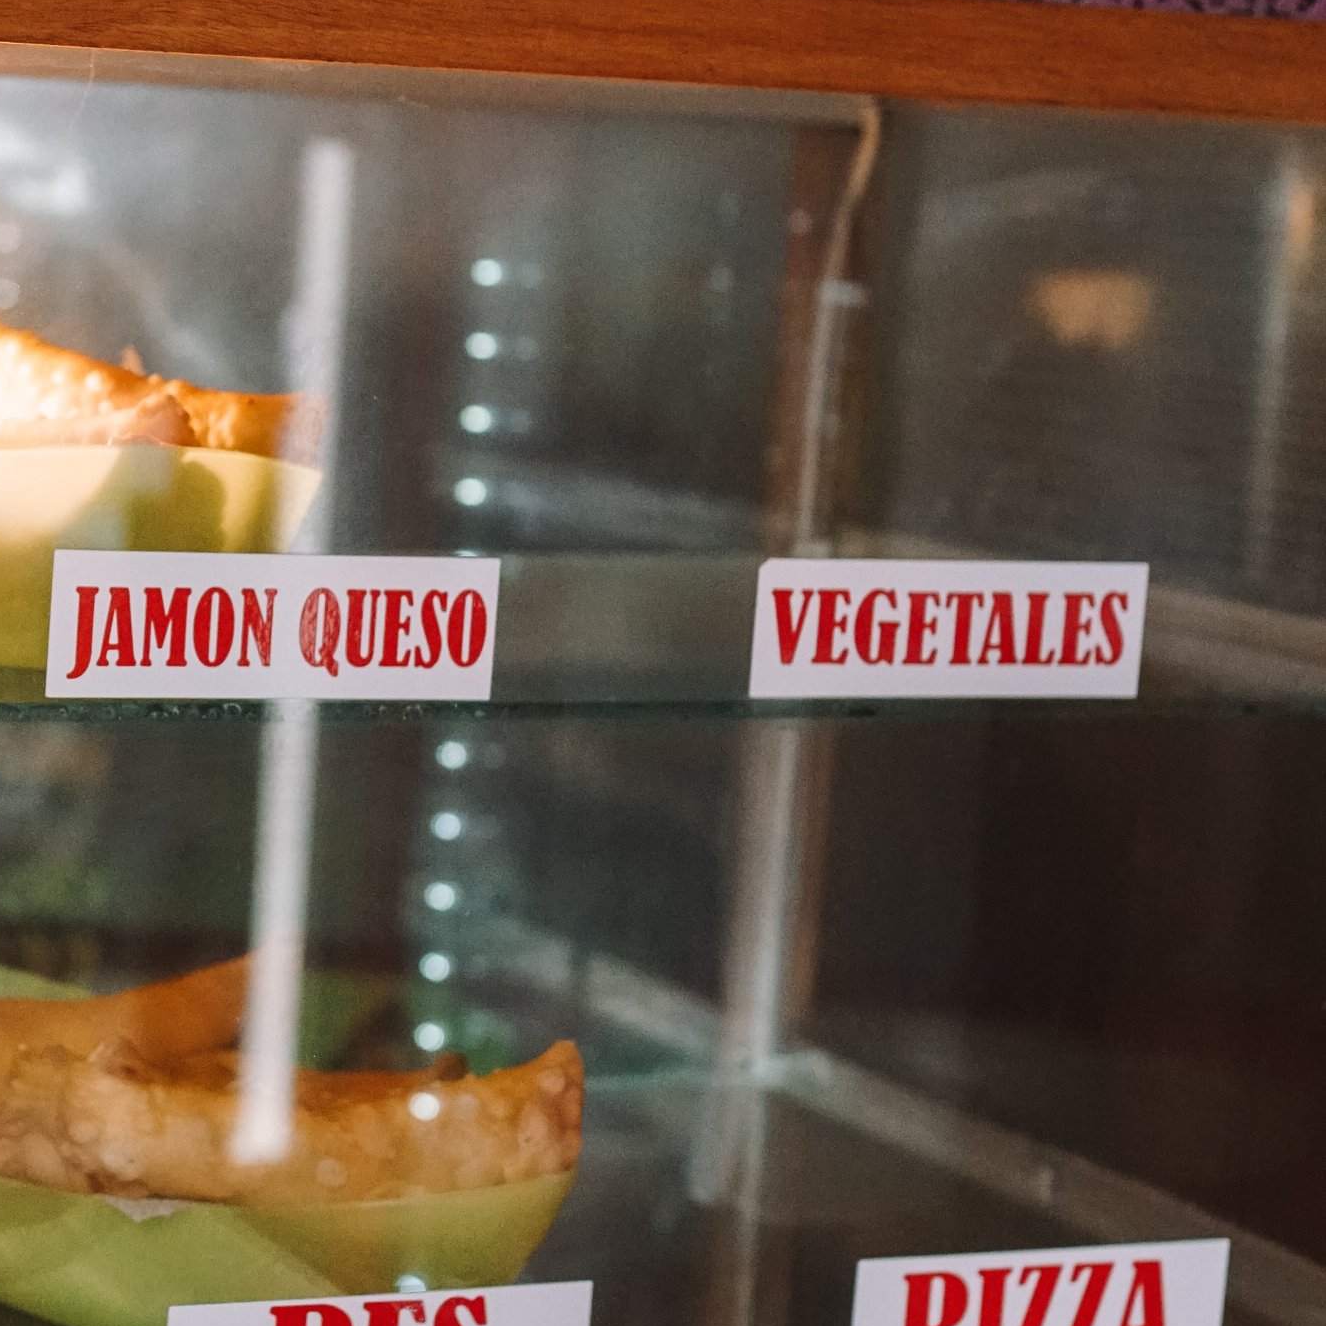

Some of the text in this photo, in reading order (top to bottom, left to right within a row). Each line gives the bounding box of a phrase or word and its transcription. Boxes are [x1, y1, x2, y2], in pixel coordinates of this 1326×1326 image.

[66, 586, 488, 680] JAMON QUESO
[772, 587, 1129, 667] VEGETALES
